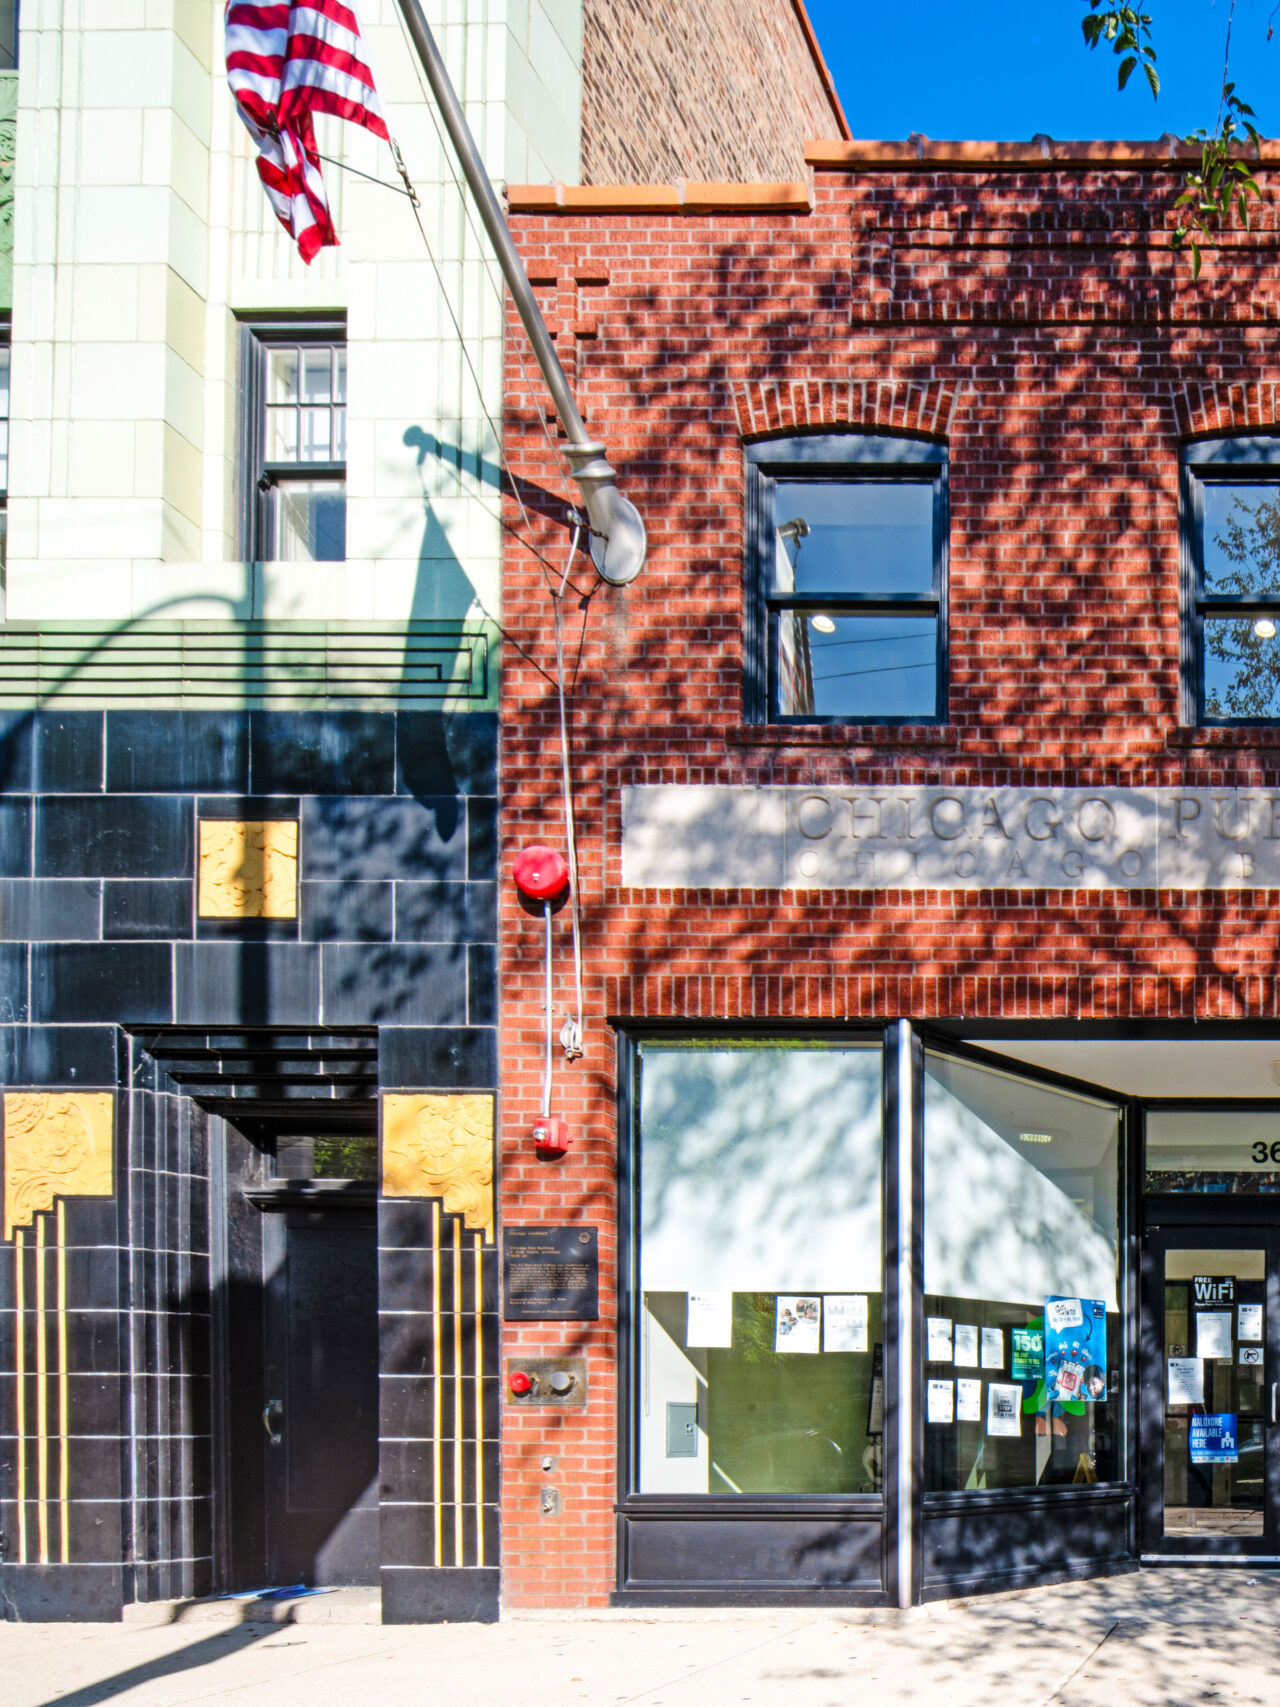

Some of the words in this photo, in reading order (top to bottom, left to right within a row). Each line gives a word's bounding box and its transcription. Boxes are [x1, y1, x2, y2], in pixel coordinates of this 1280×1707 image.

[797, 795, 1117, 842] CHICAGO
[797, 850, 1146, 879] CHICAGO
[1194, 1276, 1213, 1284] FREE
[1194, 1283, 1234, 1300] WiFi
[1013, 1334, 1043, 1352] 150
[1192, 1416, 1223, 1427] NALOXONE
[1192, 1427, 1222, 1438] AVAILABLE
[1192, 1438, 1207, 1449] HERE
